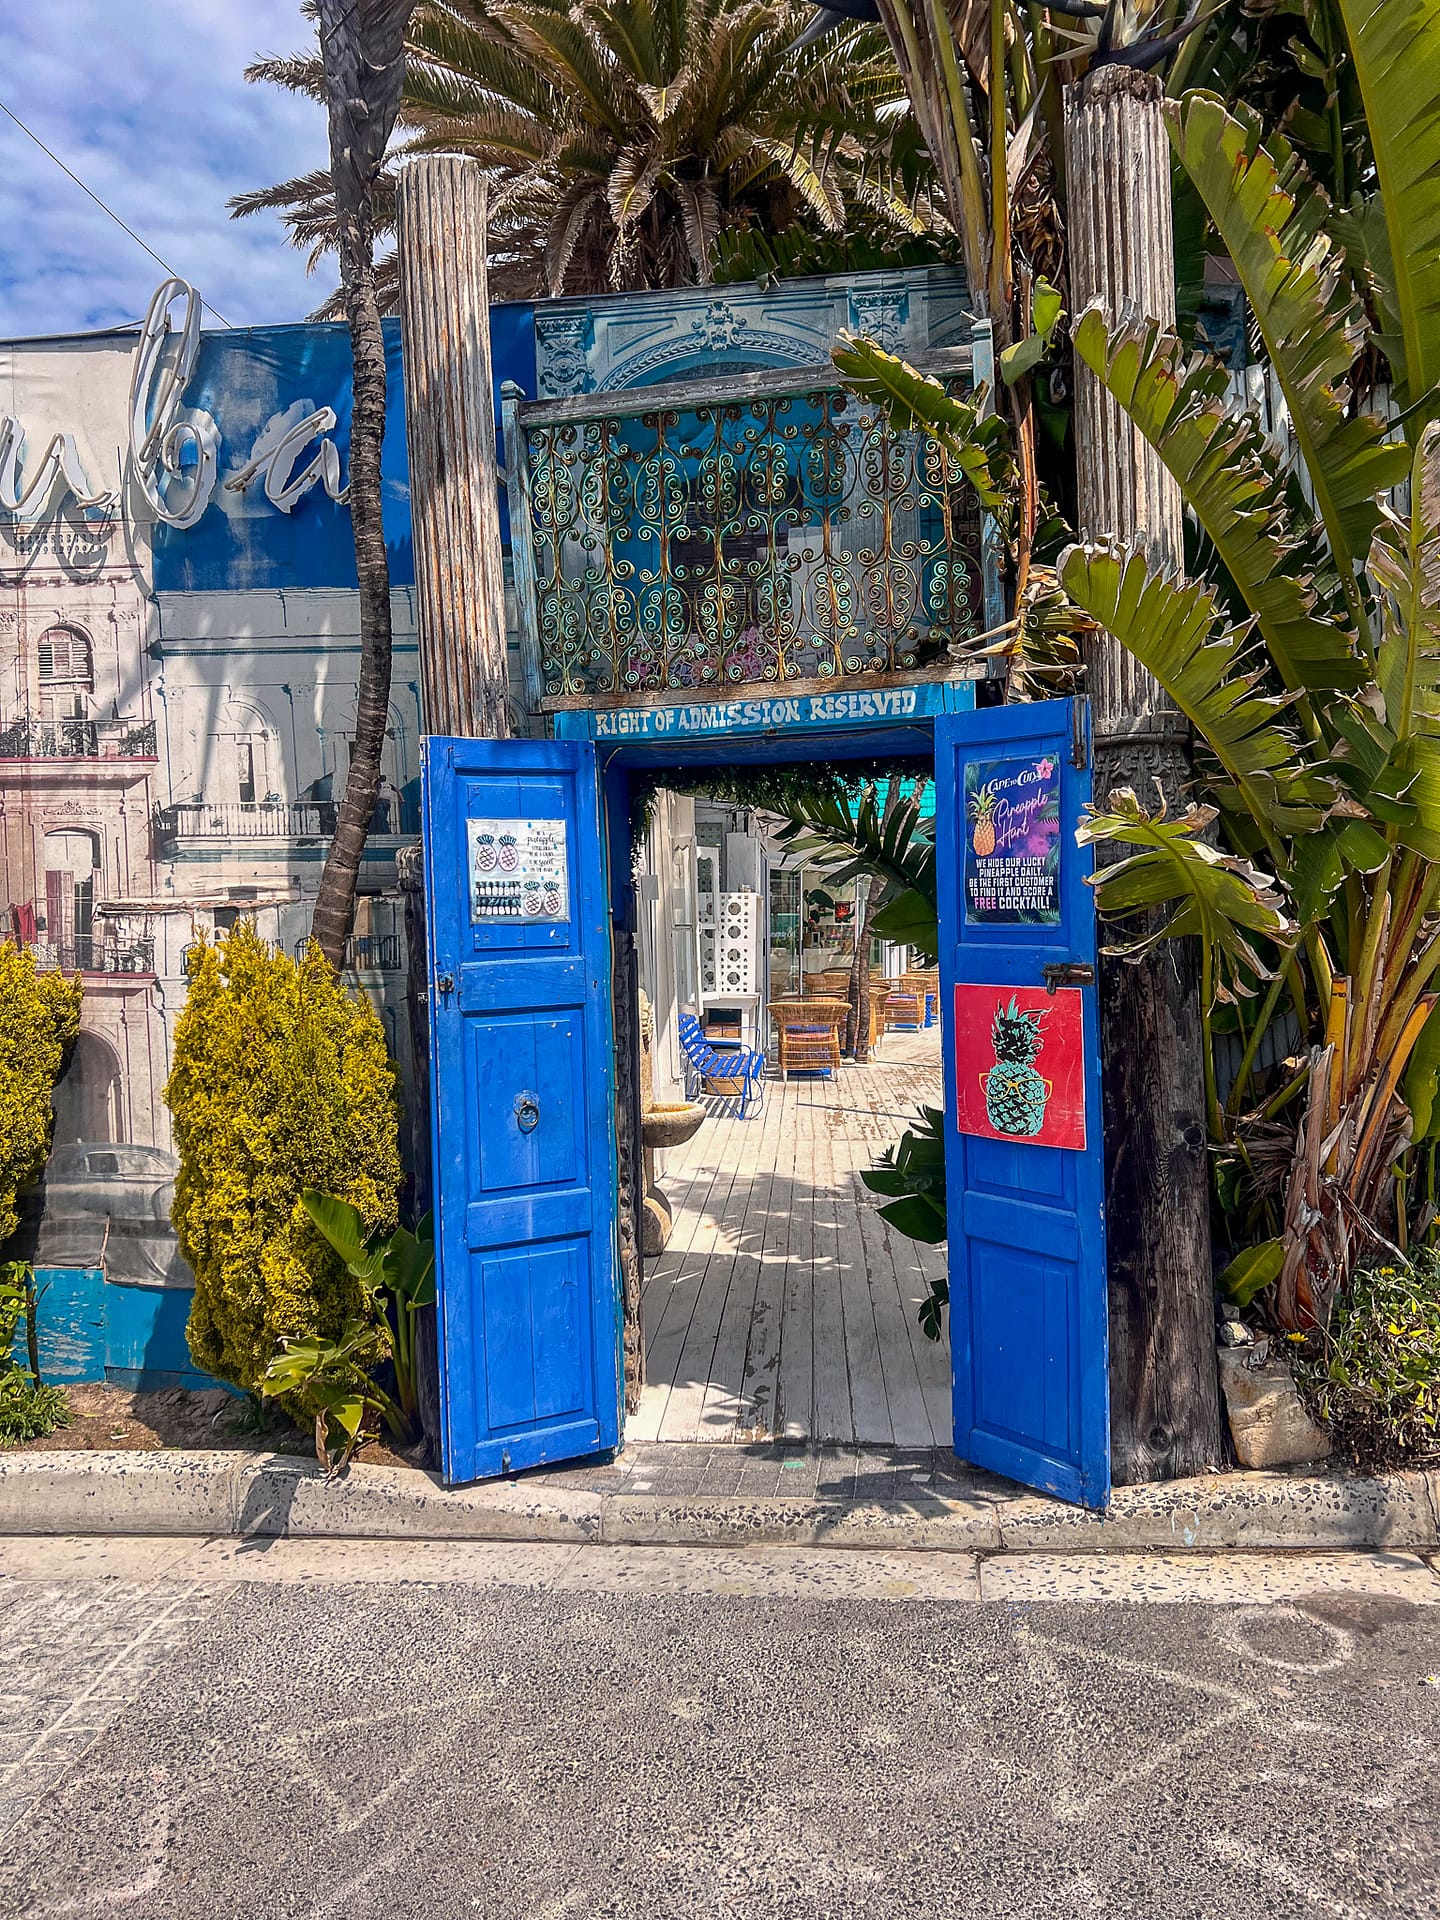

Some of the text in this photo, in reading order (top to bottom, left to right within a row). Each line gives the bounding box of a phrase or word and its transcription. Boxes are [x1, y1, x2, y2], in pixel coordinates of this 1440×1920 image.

[595, 690, 917, 736] RIGHT OF ADMISSION RESERVED
[992, 787, 1048, 827] Pineapple
[975, 856, 1046, 868] WE HIDE OUR LUCKY
[979, 866, 1043, 877] PINEAPPLE DAILY.
[969, 876, 1054, 887] BE THE FIRST CUSTOMER
[970, 886, 1054, 897] TO FIND IT AND SCORE A
[974, 896, 1050, 910] FREE COCKTAIL!
